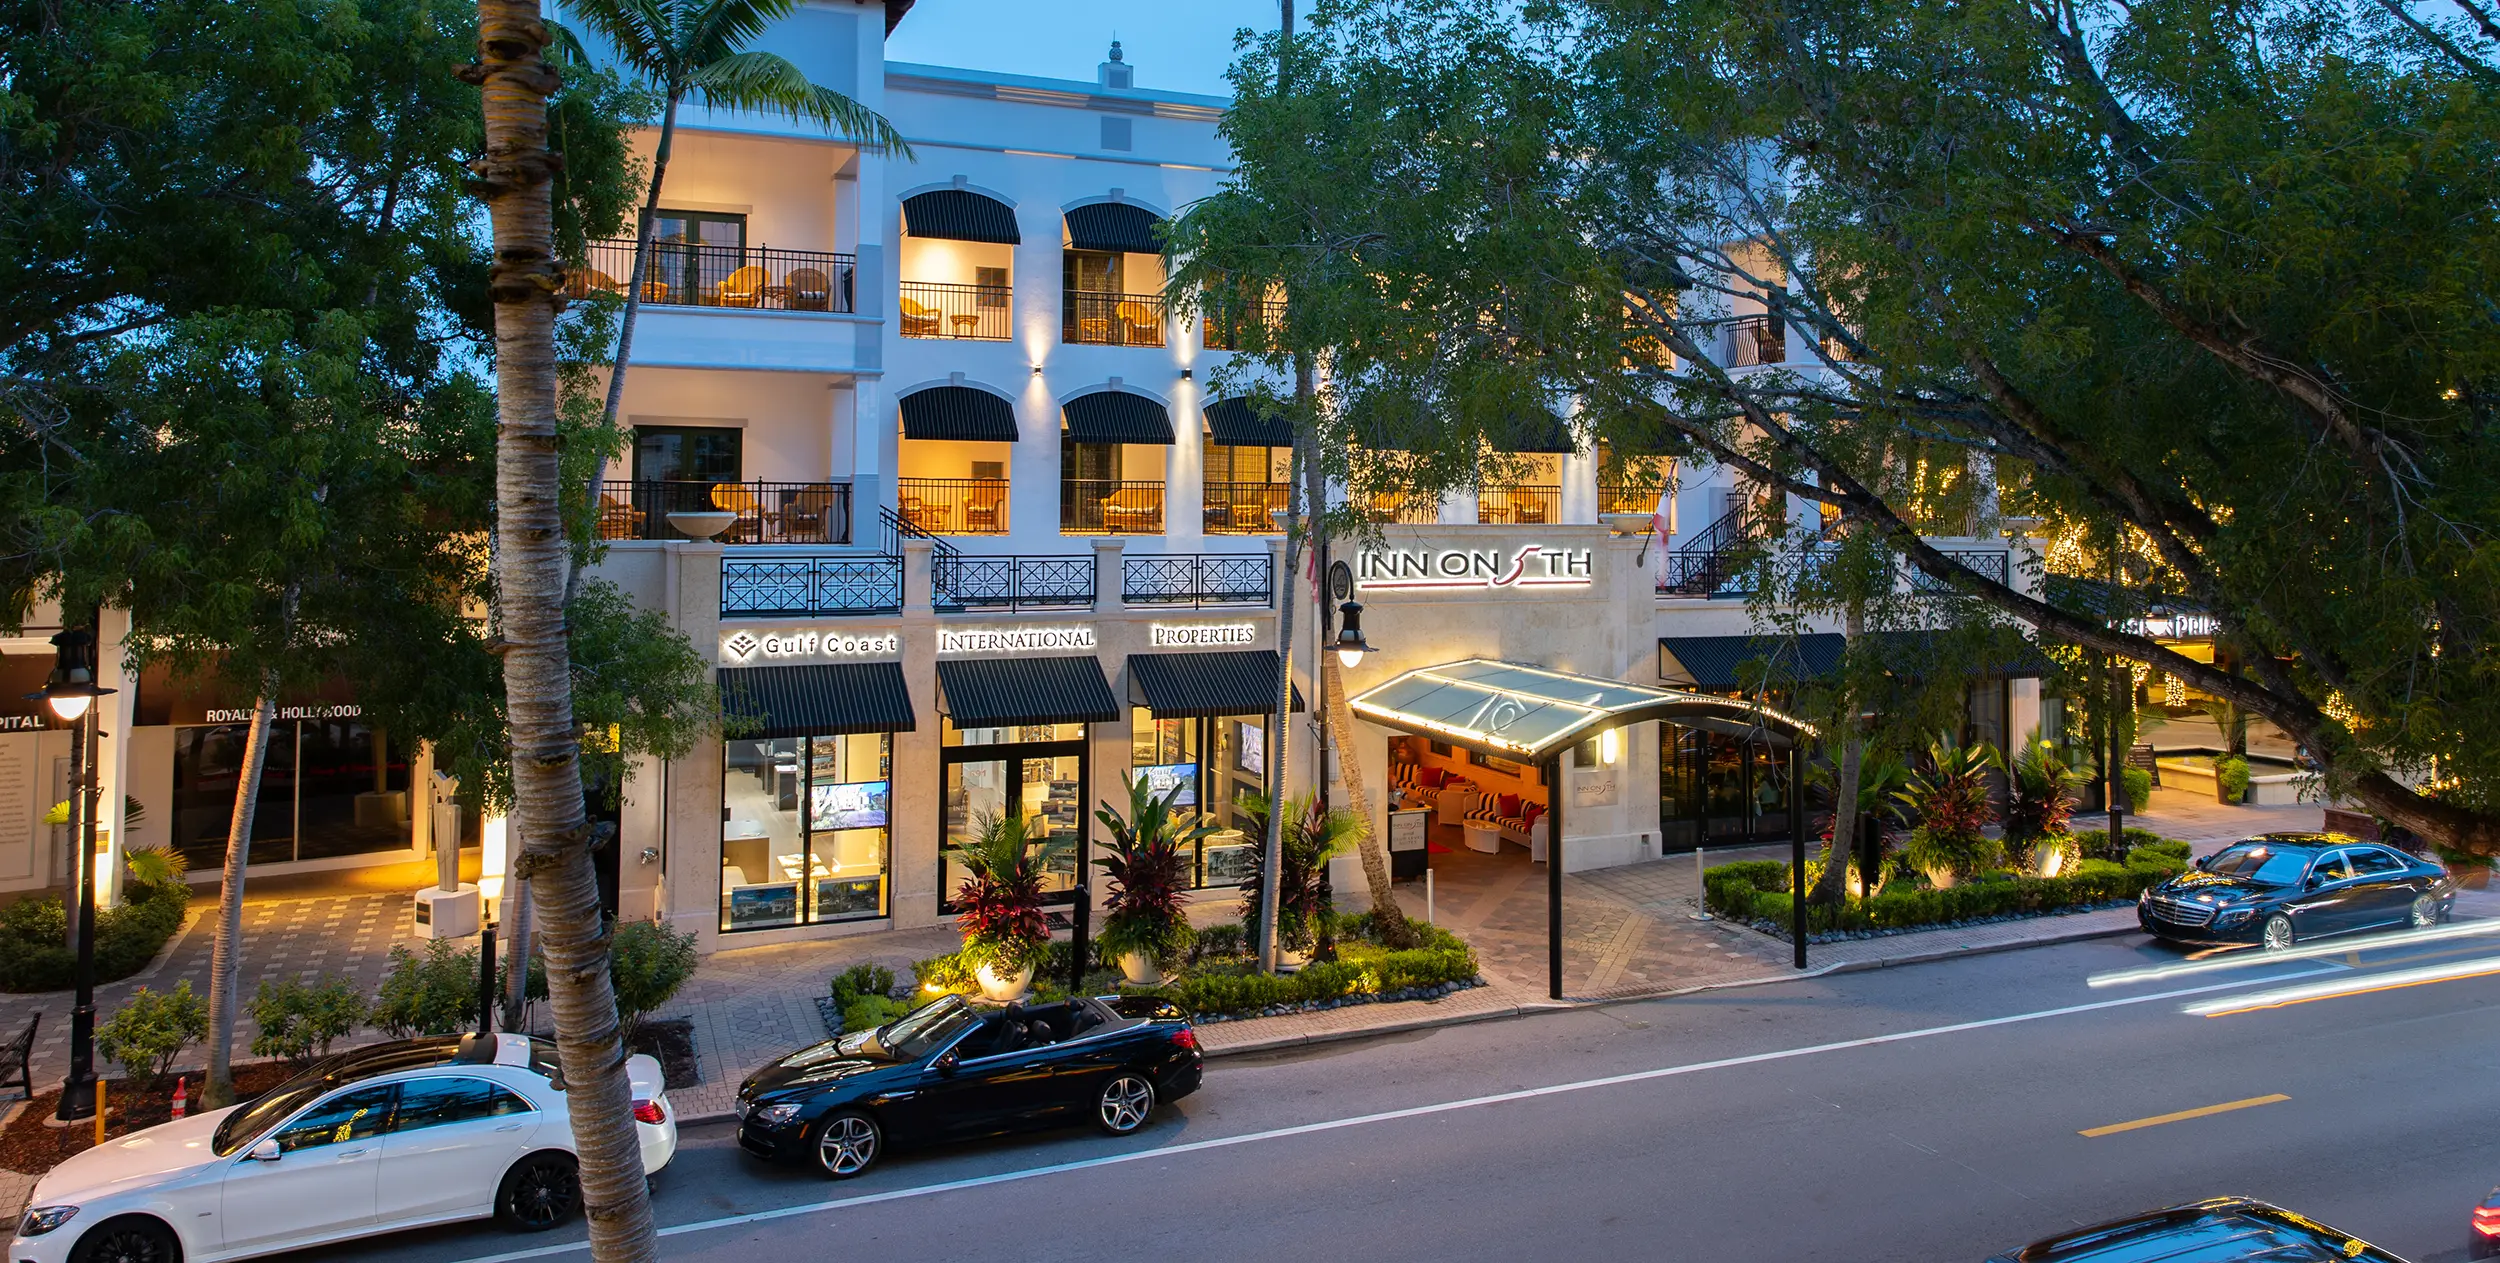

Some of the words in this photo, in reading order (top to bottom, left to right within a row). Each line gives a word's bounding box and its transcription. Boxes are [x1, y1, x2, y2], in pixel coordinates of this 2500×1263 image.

[1359, 552, 1428, 578] INN
[1440, 551, 1499, 577] ON
[1493, 546, 1592, 586] 5TH
[766, 638, 815, 653] Gulf
[827, 637, 896, 652] Coast
[941, 632, 1094, 650] INTERNATIONAL
[1155, 627, 1254, 645] PROPERTIES
[206, 708, 256, 722] ROYALT
